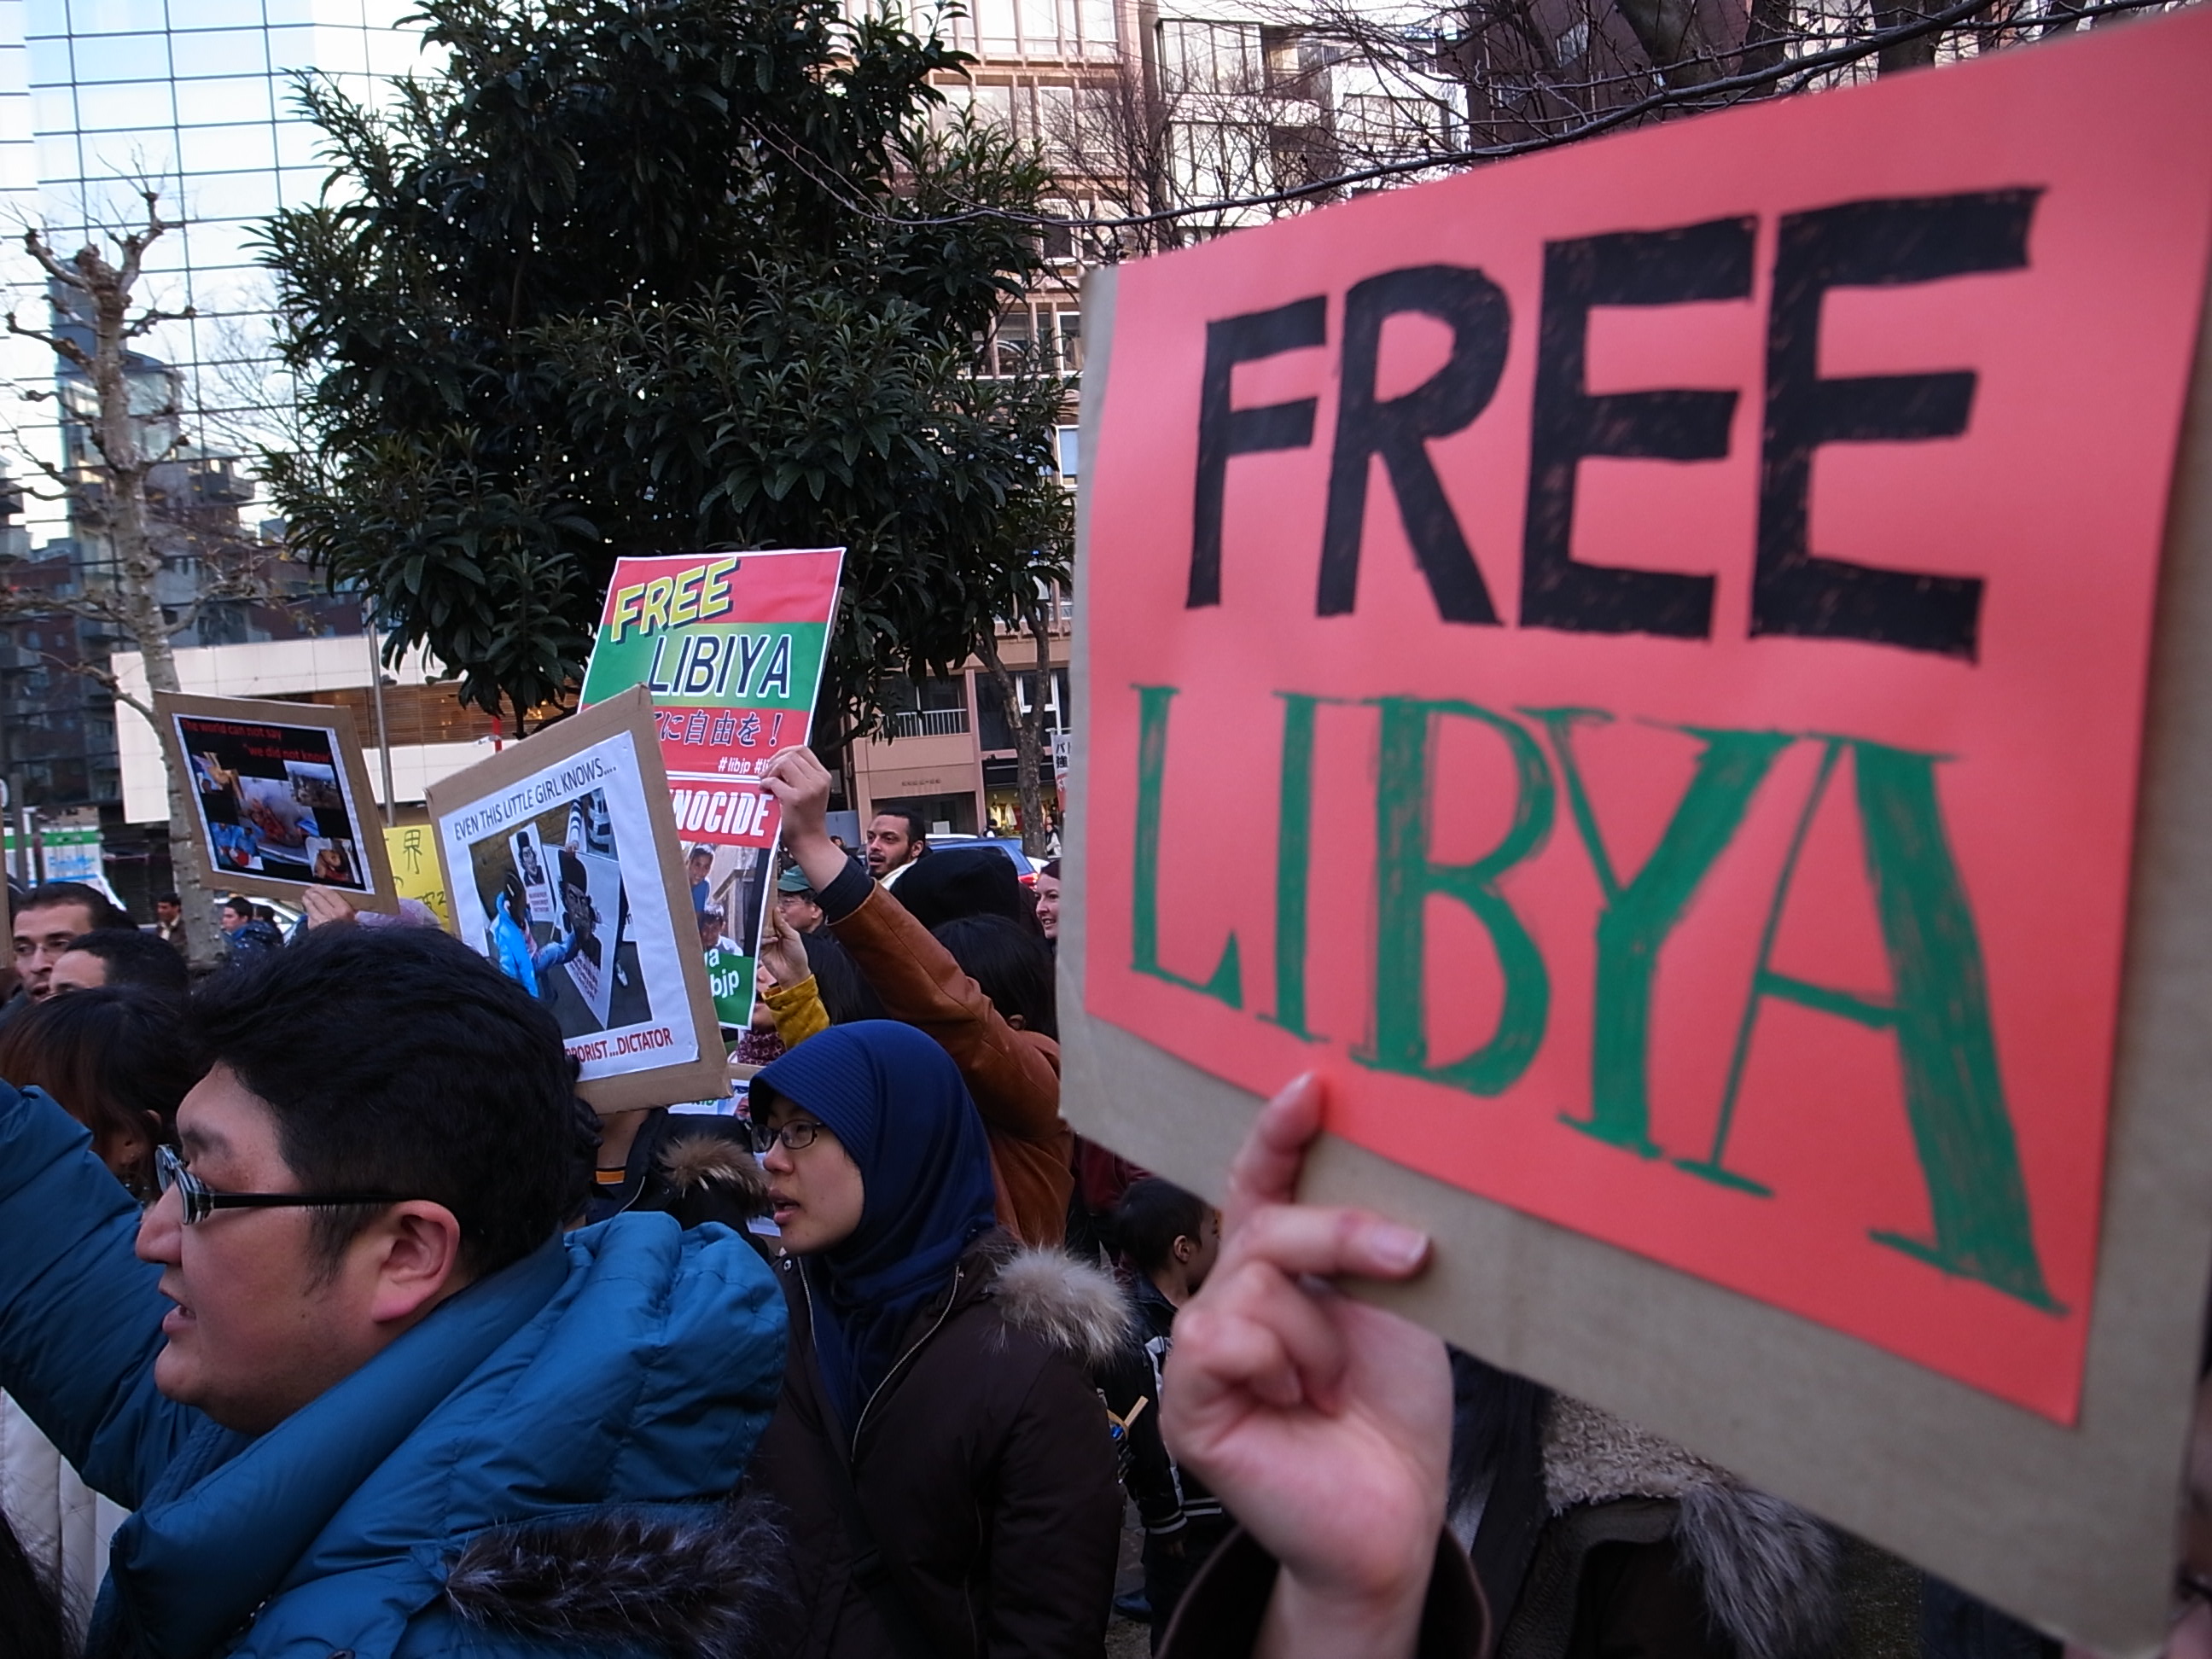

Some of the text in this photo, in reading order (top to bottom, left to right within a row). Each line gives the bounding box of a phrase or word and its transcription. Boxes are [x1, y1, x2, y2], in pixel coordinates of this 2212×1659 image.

[1185, 185, 2048, 666] FREE
[610, 556, 740, 643] FREE
[648, 634, 792, 698] LIBIYA
[201, 721, 226, 735] world
[247, 727, 264, 737] not
[267, 729, 282, 741] say
[267, 746, 282, 758] did
[283, 748, 300, 760] not
[454, 813, 480, 841] EVEN
[480, 803, 503, 830] THIS
[503, 789, 534, 819] LITTLE
[535, 777, 562, 804] GIRL
[669, 789, 774, 836] NOCIDE
[1131, 683, 2071, 1317] LIBYA
